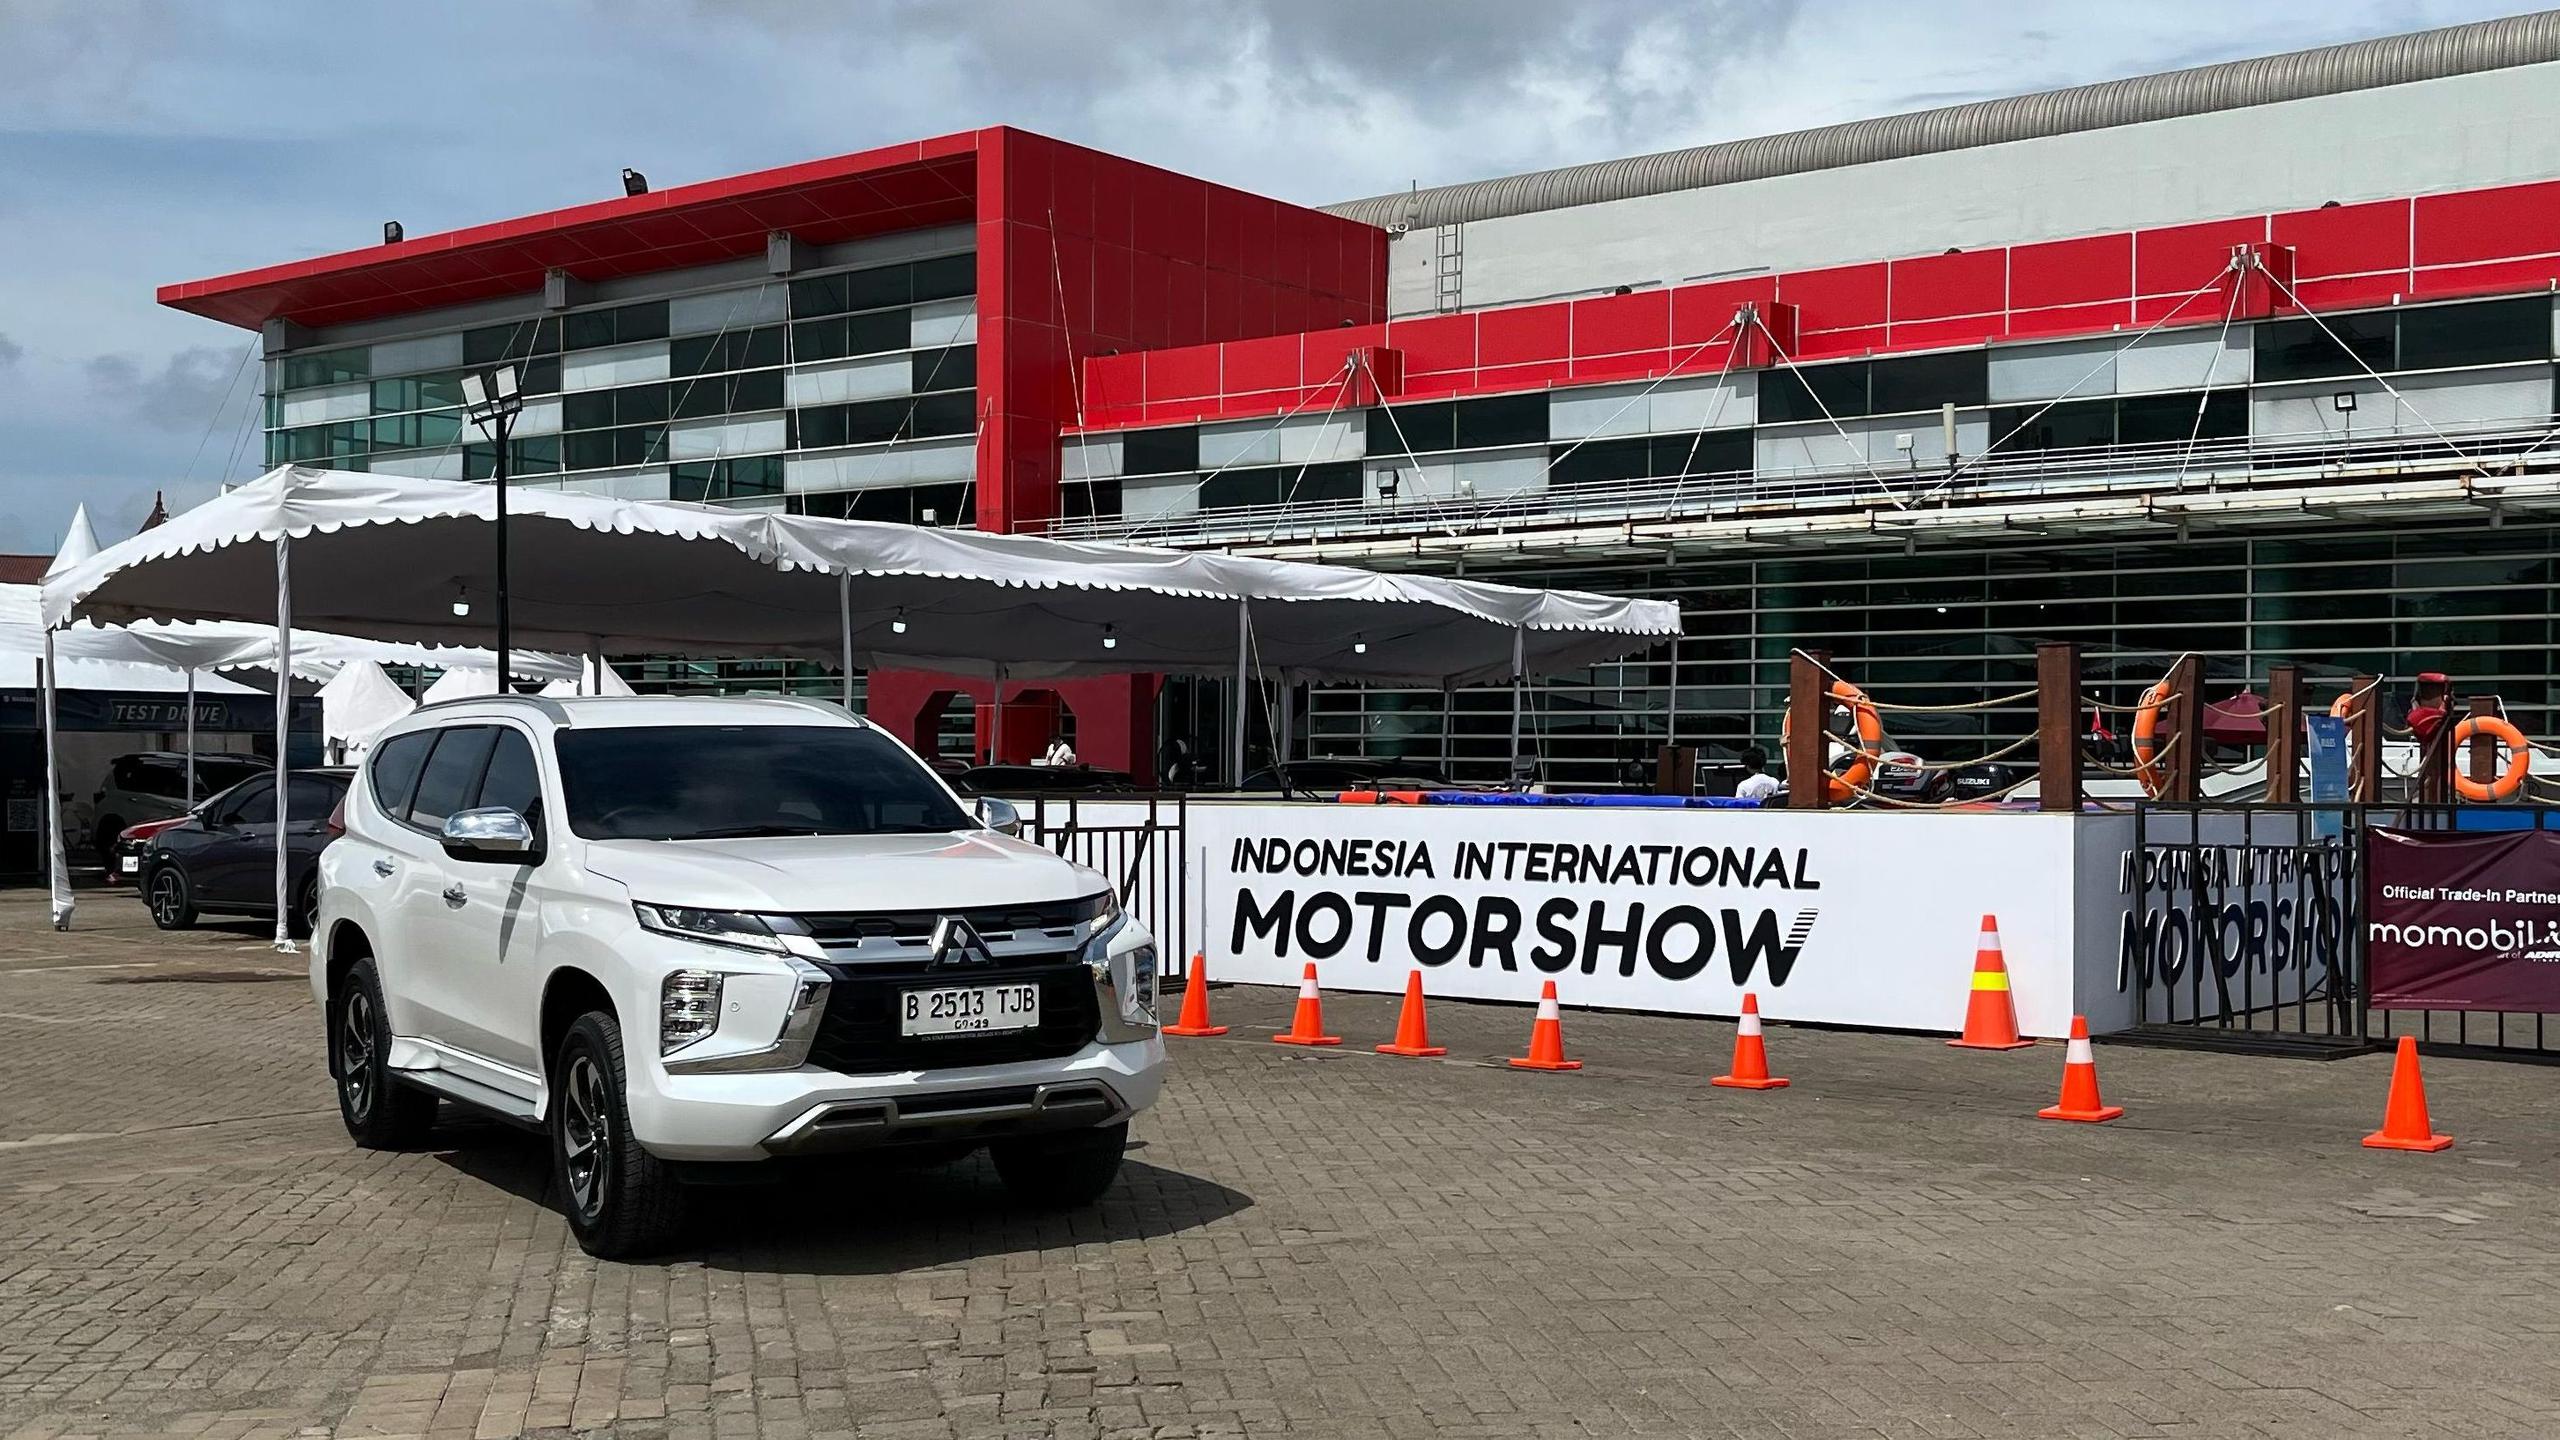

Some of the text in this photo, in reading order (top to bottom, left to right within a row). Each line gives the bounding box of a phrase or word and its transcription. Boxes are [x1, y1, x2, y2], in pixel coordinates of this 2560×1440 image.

[115, 704, 161, 721] TEST
[1231, 837, 1820, 890] INDONESIA INTERNATIONAL
[2382, 884, 2435, 900] Official
[2439, 887, 2501, 902] Trade-In
[1231, 887, 1819, 987] MOTORSHOW
[2117, 897, 2357, 993] MOTORSHO
[906, 987, 1035, 1020] B 2513 TJB
